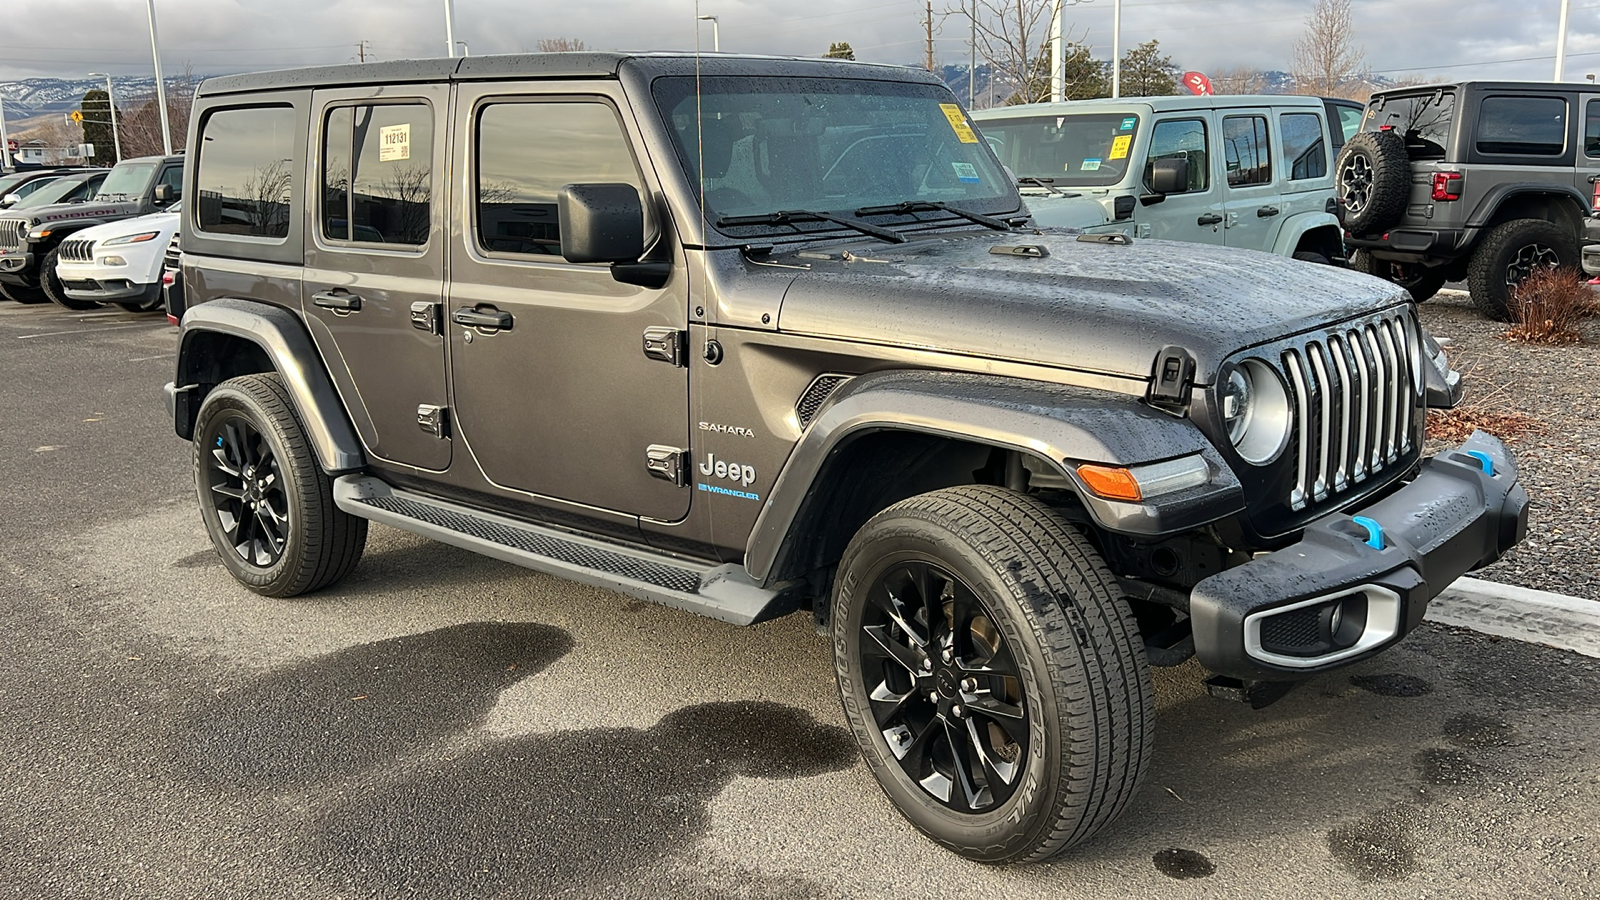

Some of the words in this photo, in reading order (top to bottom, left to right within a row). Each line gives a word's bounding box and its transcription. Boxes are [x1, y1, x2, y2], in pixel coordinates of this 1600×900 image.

[385, 132, 407, 145] 112131
[46, 209, 117, 221] RUBICON
[699, 421, 756, 438] SAHARA
[699, 453, 757, 487] Jeep
[707, 484, 760, 501] WRANGLER
